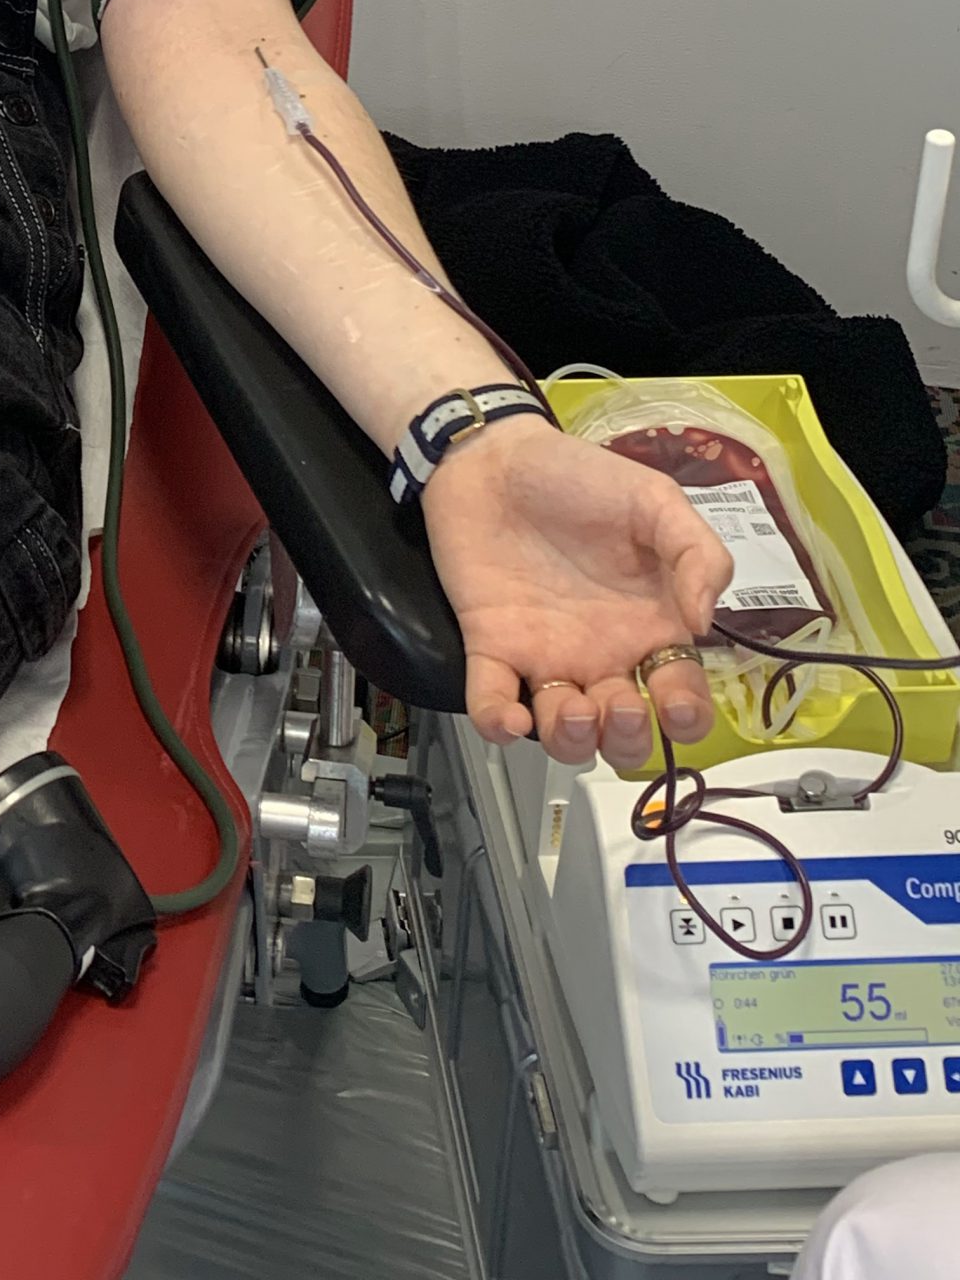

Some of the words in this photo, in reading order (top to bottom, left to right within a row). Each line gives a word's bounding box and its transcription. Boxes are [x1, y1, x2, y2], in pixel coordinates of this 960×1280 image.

[905, 877, 960, 903] Comp
[841, 983, 892, 1022] 55
[722, 1066, 803, 1081] FRESENIUS
[724, 1085, 760, 1098] KABI
